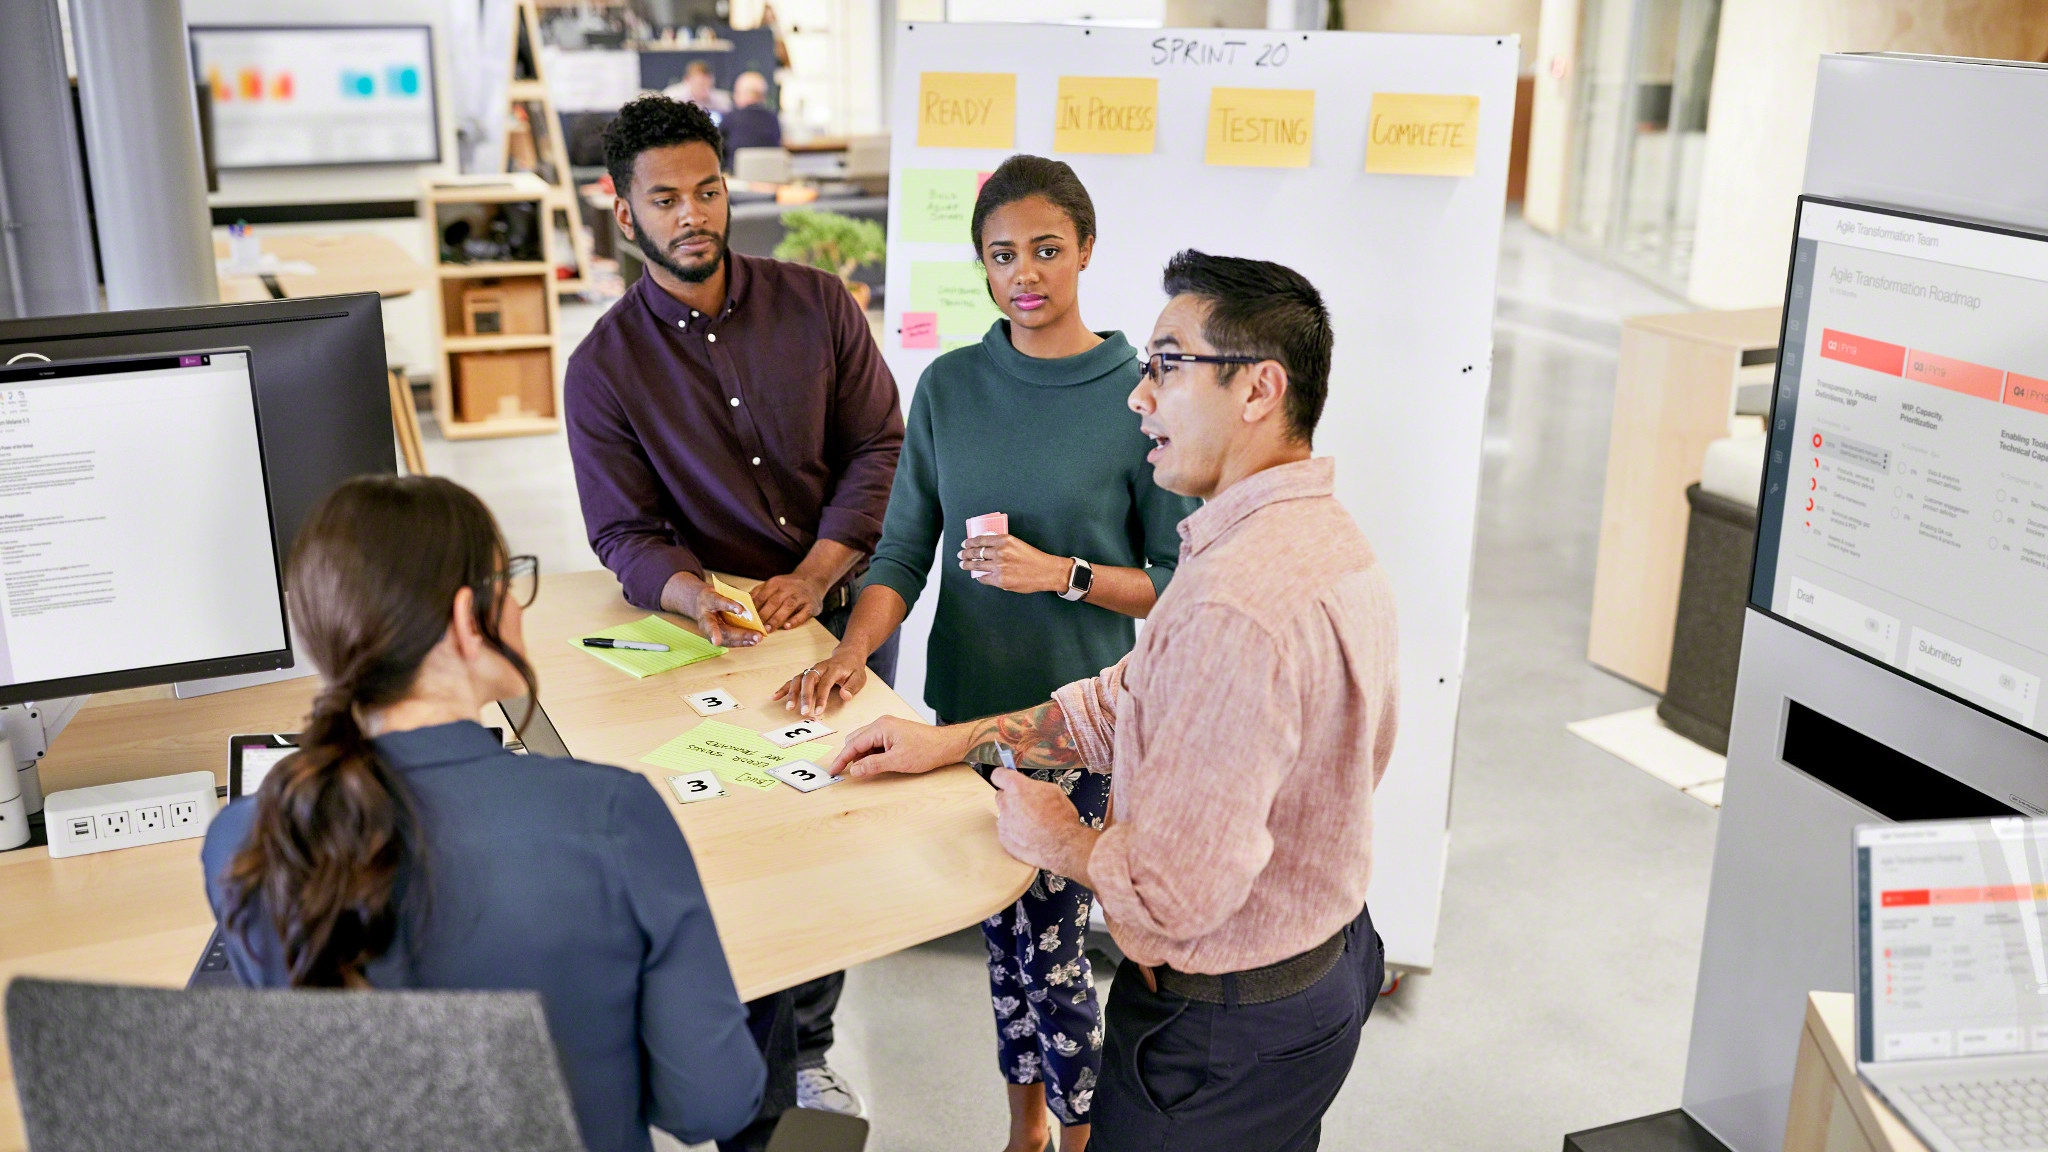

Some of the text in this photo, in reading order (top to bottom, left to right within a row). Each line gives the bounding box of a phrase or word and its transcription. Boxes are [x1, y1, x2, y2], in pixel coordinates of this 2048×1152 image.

[1151, 37, 1289, 67] SPRINT 20
[924, 90, 994, 126] READY
[1056, 95, 1155, 132] IN PROCESS
[1217, 107, 1307, 145] TESTING
[1372, 113, 1466, 148] COMPLETE
[1836, 219, 1940, 248] Agile Transformation Team
[1829, 266, 1854, 285] Agile
[1856, 270, 1927, 298] Transformation
[1928, 284, 1982, 312] Roadmap
[1827, 340, 1838, 350] Q2
[1913, 361, 1947, 378] Q3 FY19
[1854, 389, 1877, 403] Product
[2013, 386, 2025, 397] Q4
[1900, 413, 1938, 431] Prioritization
[1915, 406, 1944, 422] Capacity,
[2000, 429, 2030, 446] Enabling
[1999, 441, 2031, 457] Technical
[1796, 588, 1815, 605] Draft
[1918, 640, 1962, 668] Submitted
